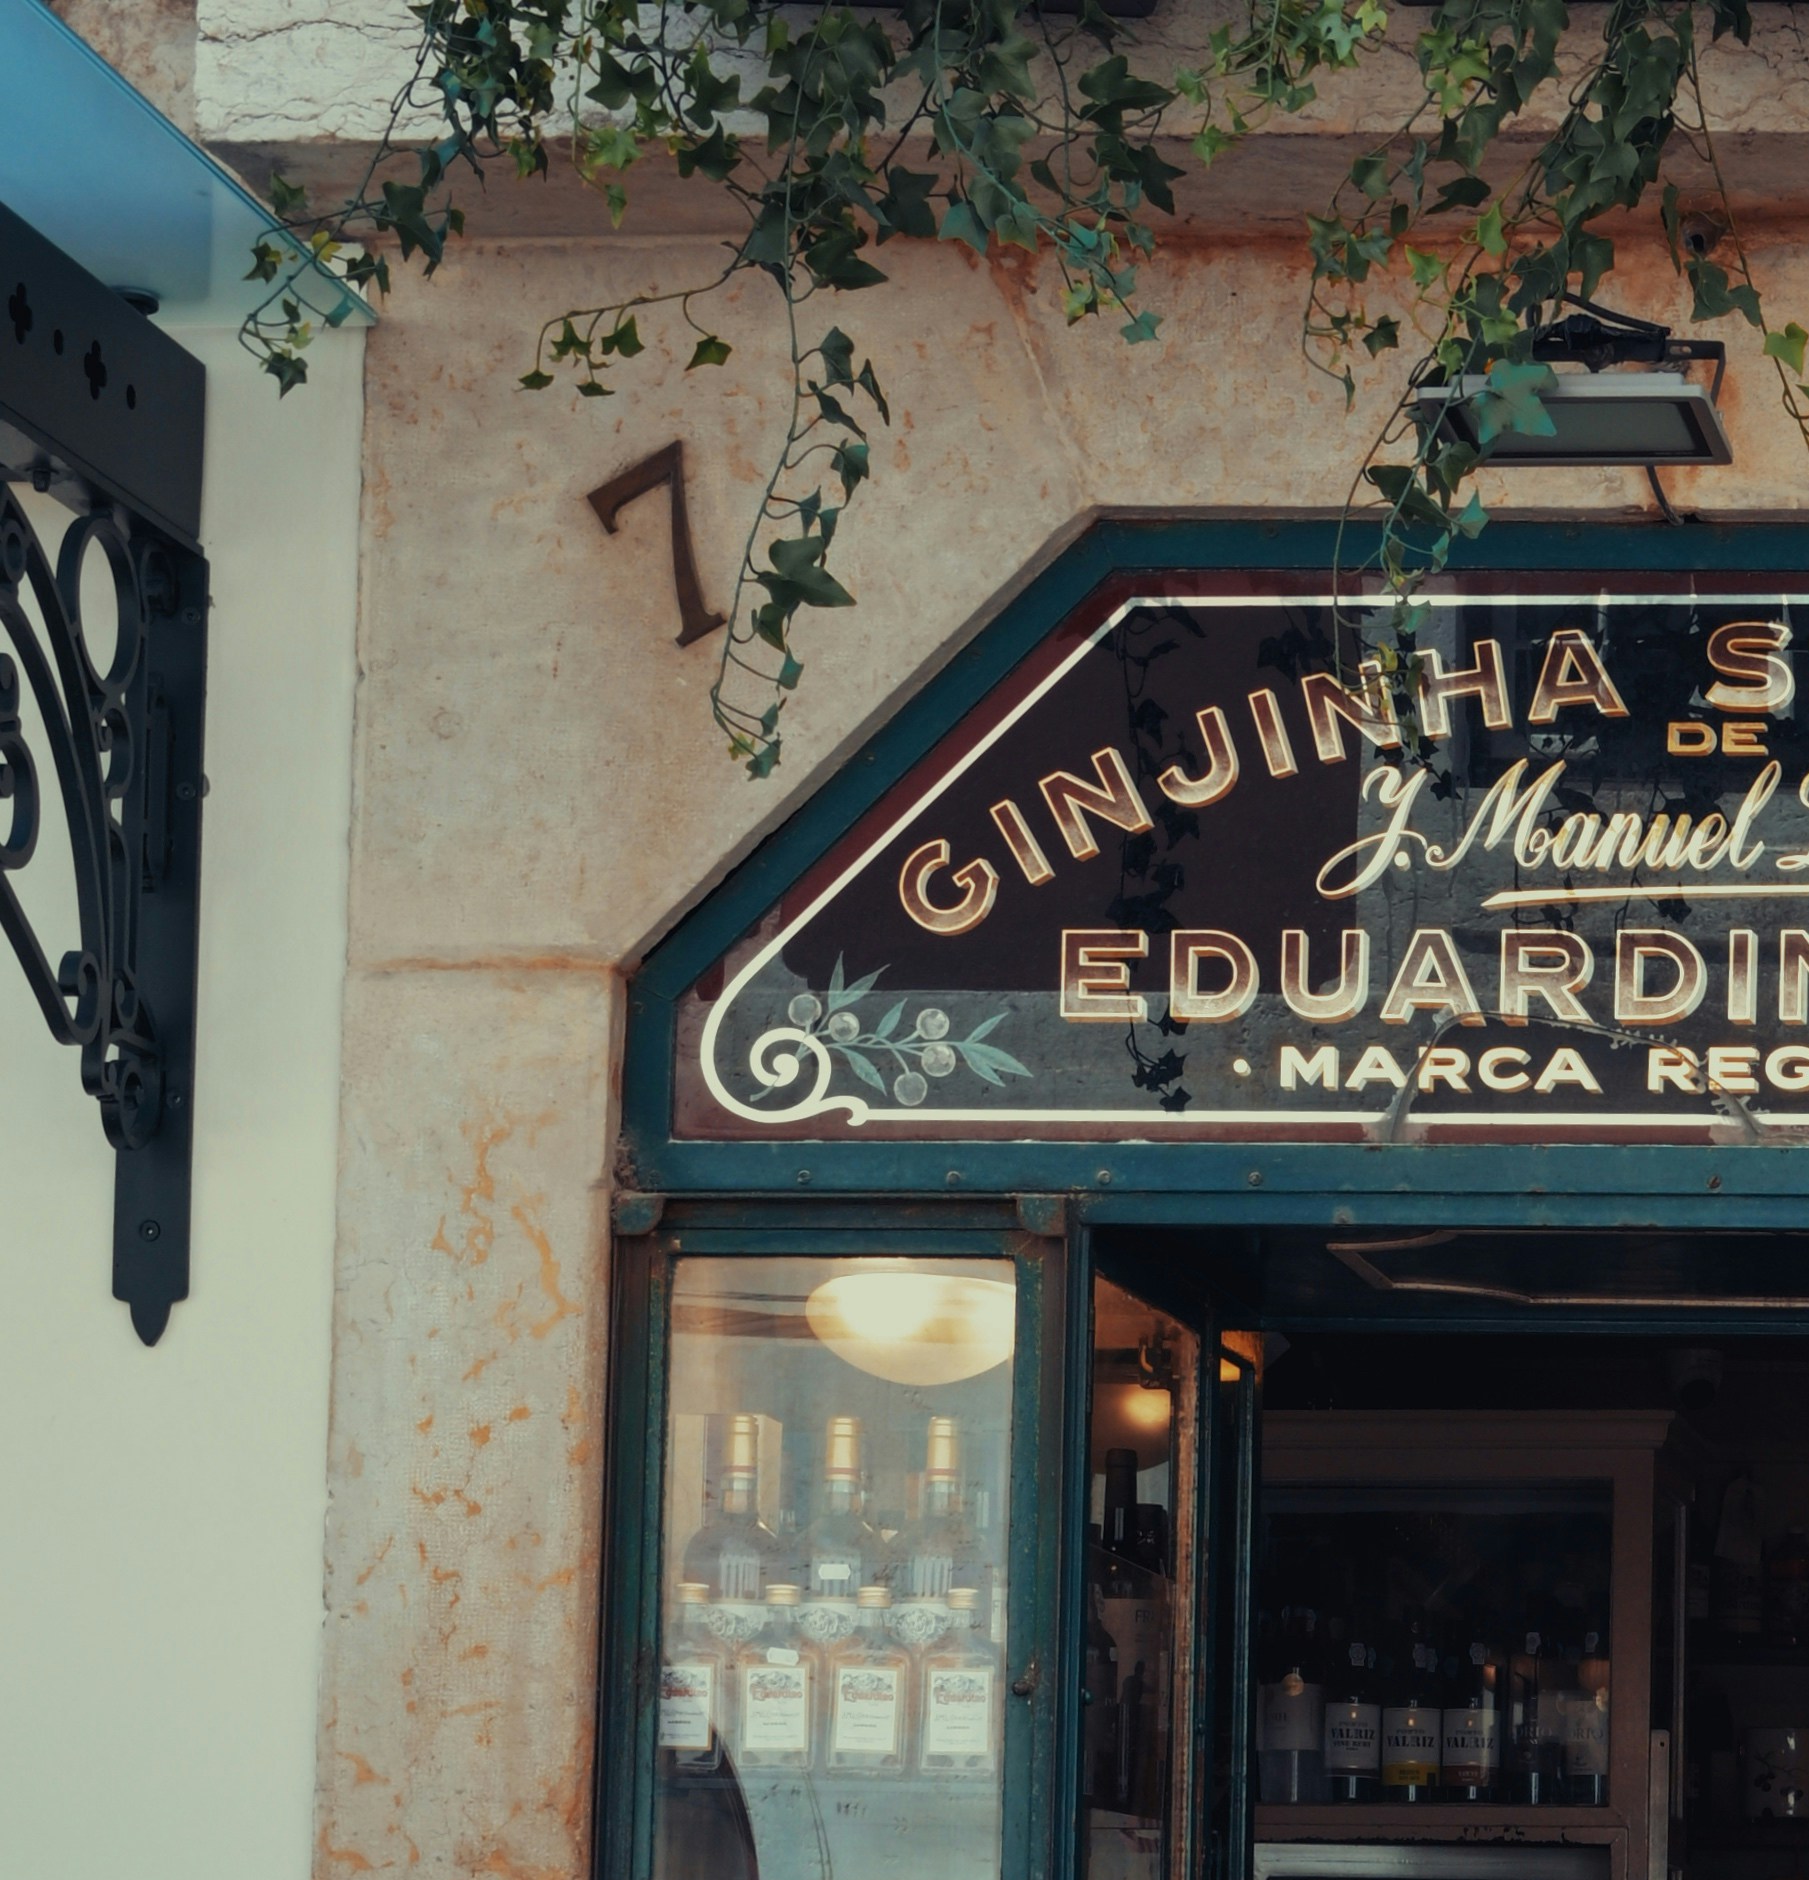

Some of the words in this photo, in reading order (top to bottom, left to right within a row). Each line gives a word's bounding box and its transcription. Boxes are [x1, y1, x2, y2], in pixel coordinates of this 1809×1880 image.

[585, 439, 727, 649] 7
[1667, 719, 1770, 758] DE
[897, 628, 1631, 935] GINJINHA
[1428, 757, 1782, 875] Manuel
[1278, 1044, 1601, 1097] MARCA
[1331, 1727, 1376, 1740] VALRIZ
[1387, 1735, 1435, 1748] VALRIZ
